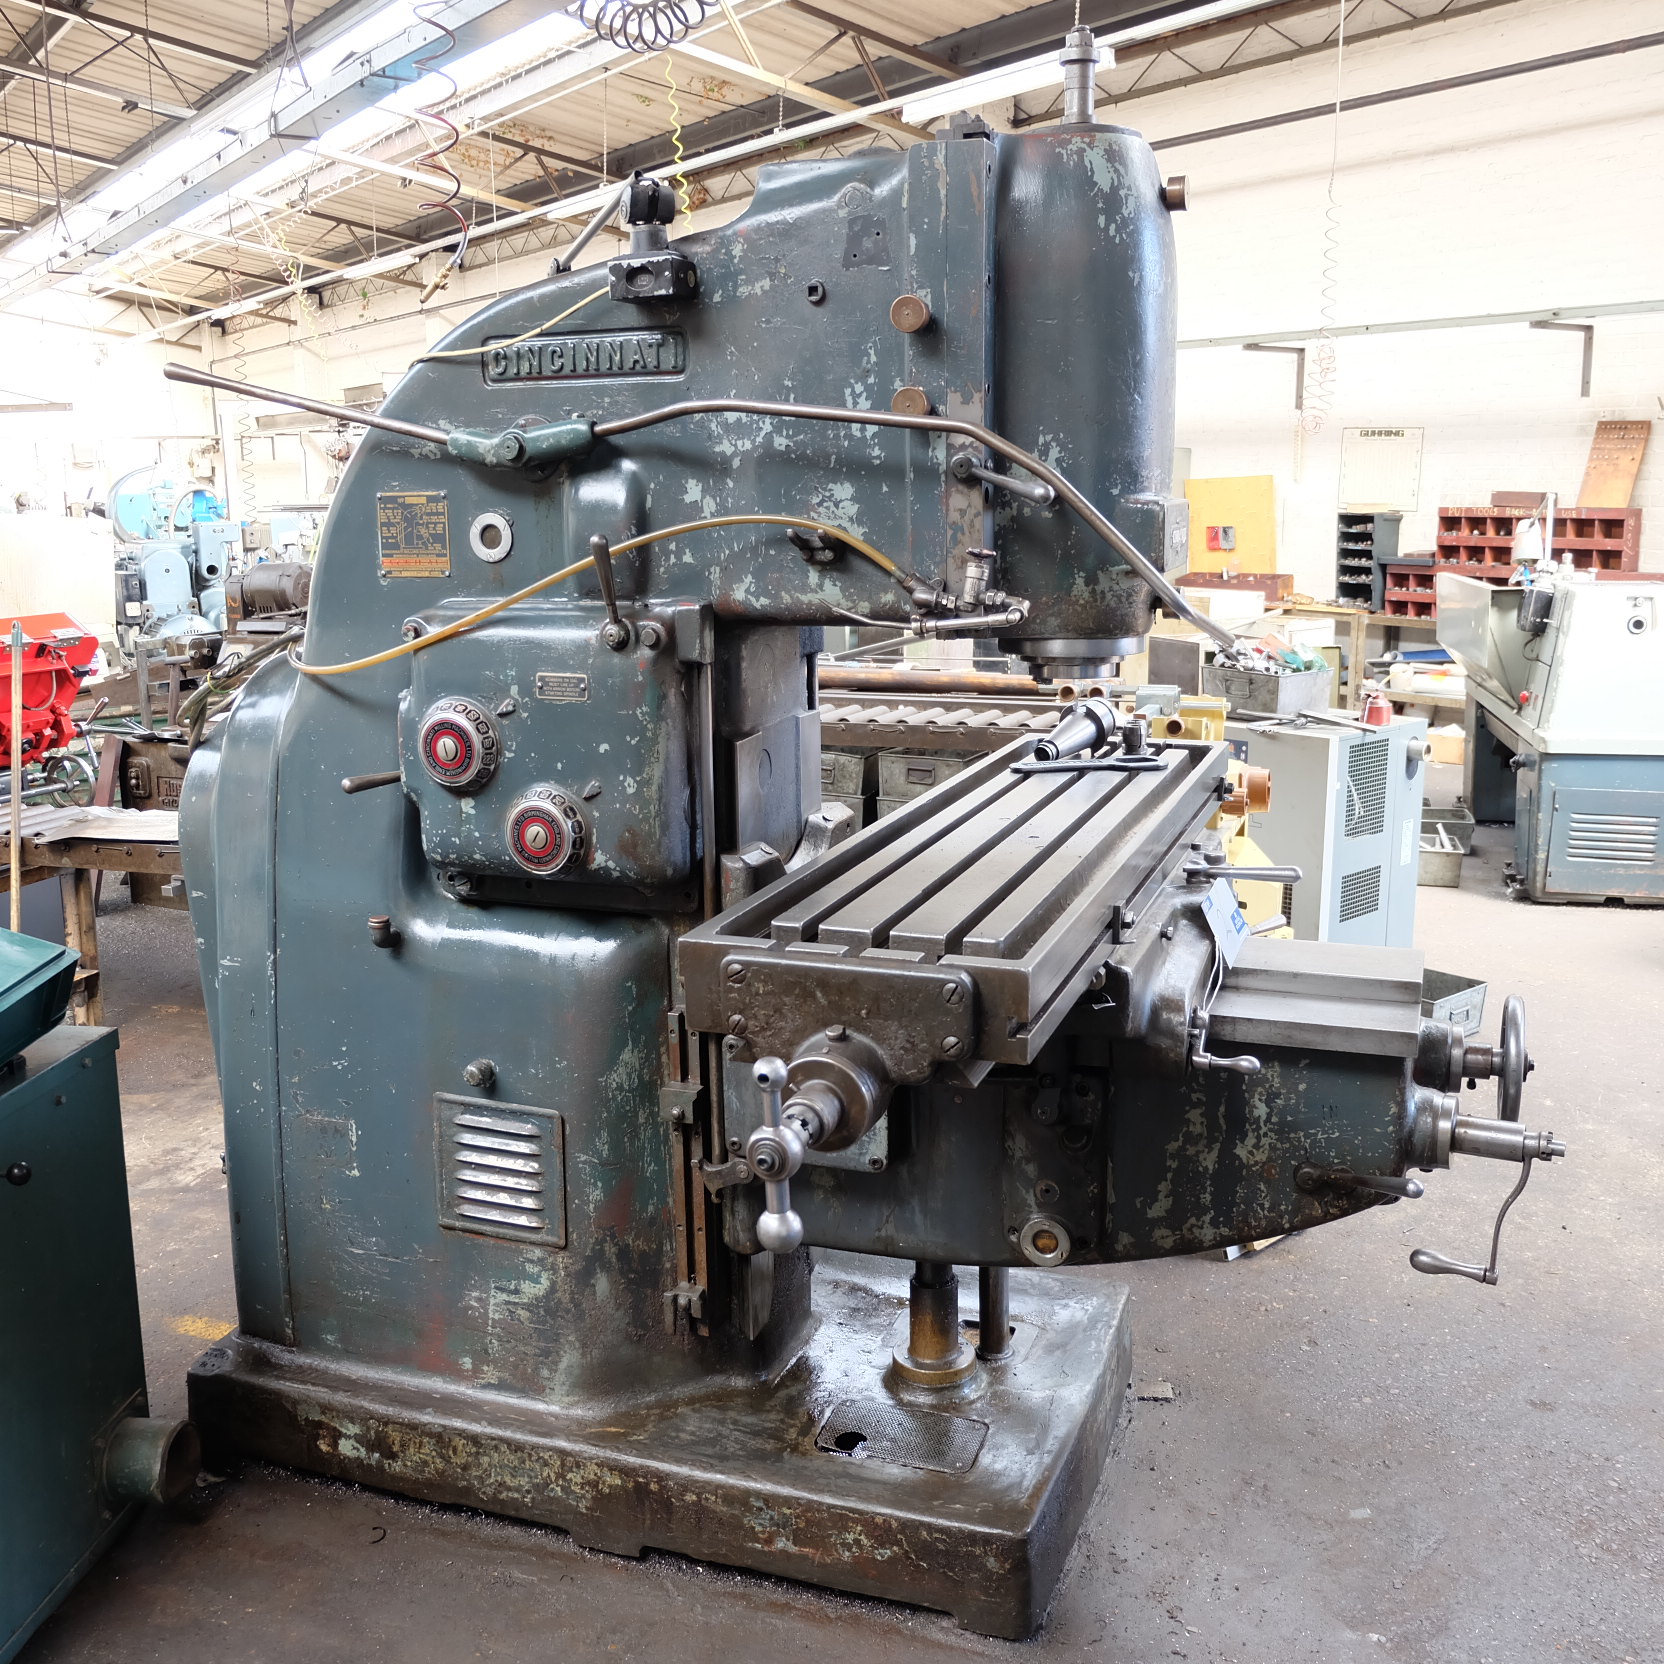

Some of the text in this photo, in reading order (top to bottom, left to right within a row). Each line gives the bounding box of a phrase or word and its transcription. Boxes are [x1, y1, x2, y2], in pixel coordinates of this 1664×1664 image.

[490, 335, 679, 376] CINCINNATI
[1448, 507, 1466, 517] PUT
[1561, 510, 1577, 518] USE
[482, 754, 494, 764] 223
